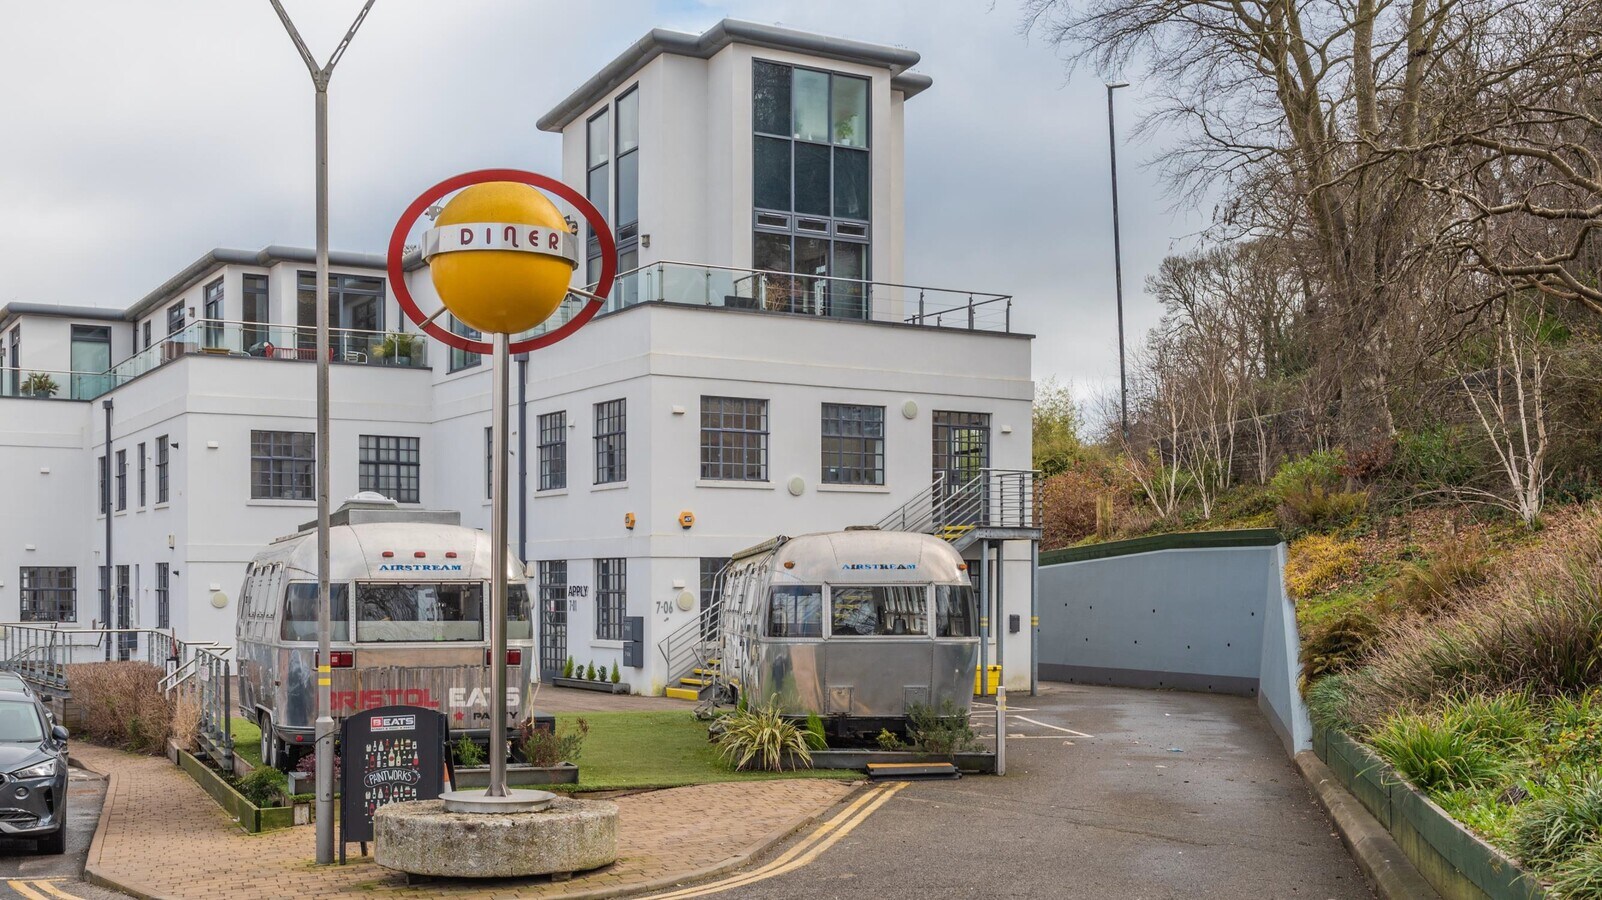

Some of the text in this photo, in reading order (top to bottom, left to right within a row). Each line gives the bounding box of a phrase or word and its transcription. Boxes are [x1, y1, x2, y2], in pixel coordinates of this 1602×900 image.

[461, 226, 559, 250] DINER
[568, 585, 588, 597] APPLY
[656, 601, 673, 614] 7-06
[449, 687, 521, 708] EAS
[473, 711, 519, 721] PAY
[369, 769, 412, 785] PAINTWORKS
